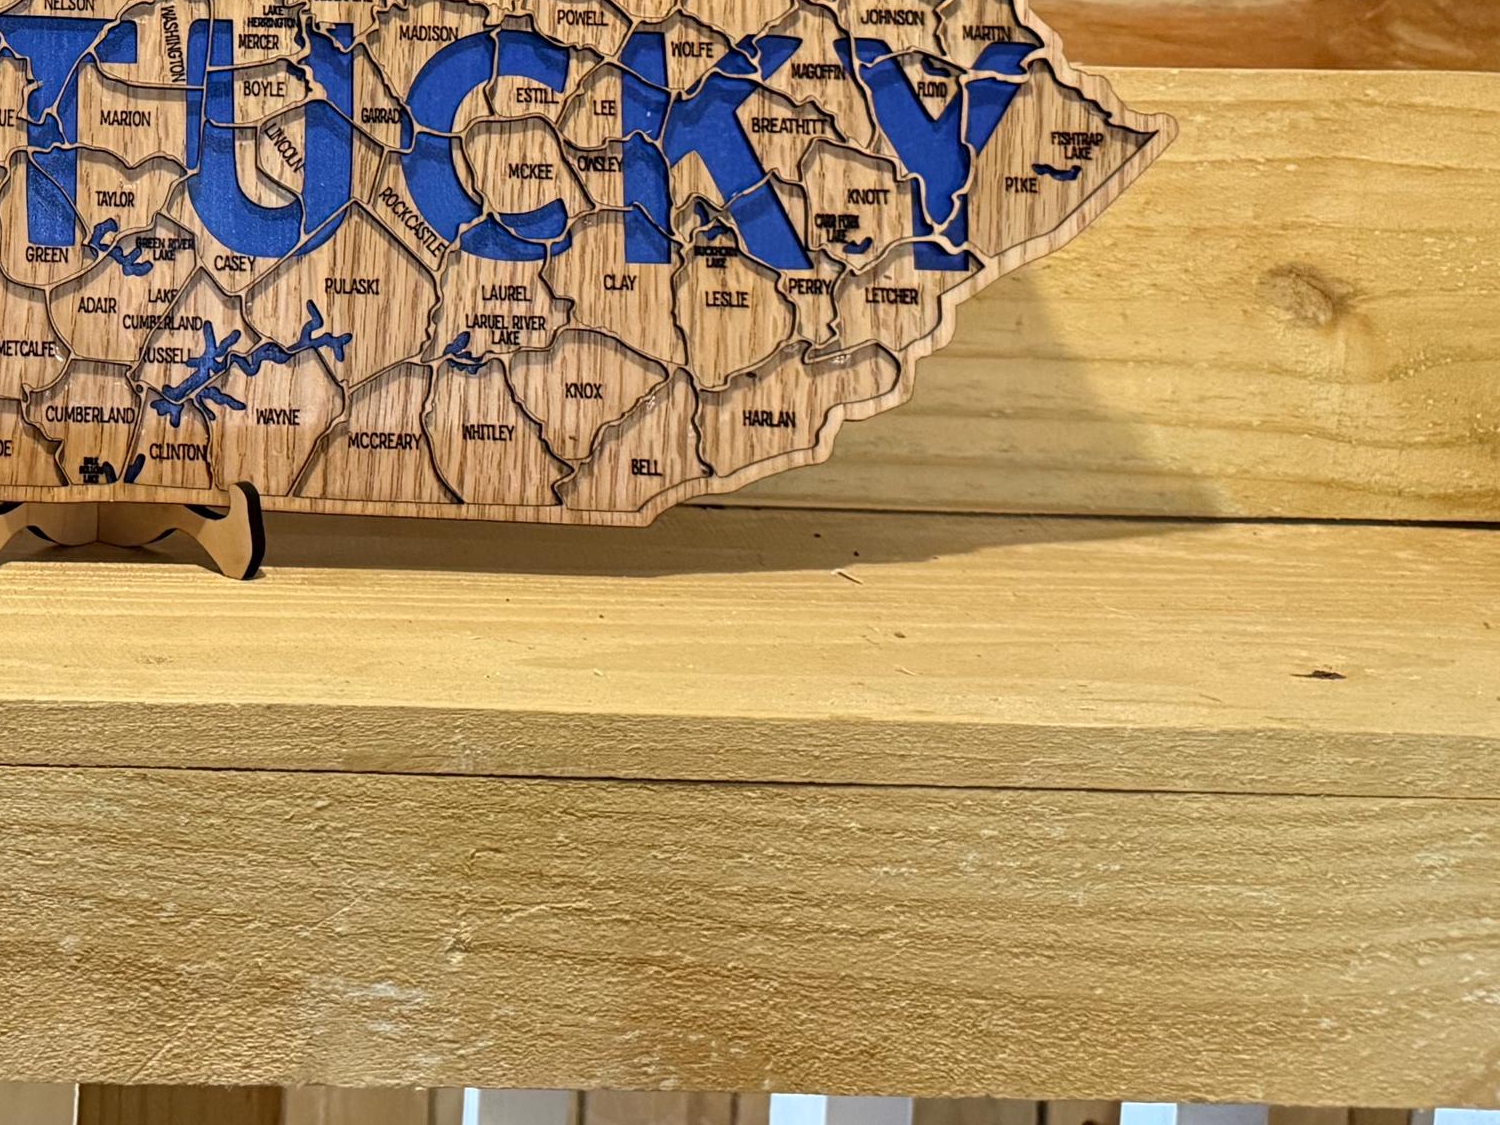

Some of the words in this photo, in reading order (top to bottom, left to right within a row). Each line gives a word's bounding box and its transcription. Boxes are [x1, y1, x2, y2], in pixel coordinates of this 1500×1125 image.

[557, 9, 608, 25] POWELL
[861, 9, 924, 25] JOHNSON
[238, 34, 279, 50] MERCER
[399, 25, 459, 42] MADISON
[963, 25, 1011, 42] MARTIN
[161, 5, 186, 83] WASHINGTON
[671, 41, 713, 58] WOLFE
[791, 63, 846, 80] MAGOFFIN
[243, 80, 285, 97] BOYLE
[516, 88, 559, 104] ESTILL
[917, 81, 947, 98] FLOYD
[593, 100, 615, 115] LEE
[101, 110, 150, 126] MARION
[751, 118, 827, 135] BREATHITT
[1051, 131, 1103, 146] FISHTRAP
[264, 123, 305, 173] LINCOLN
[1064, 146, 1092, 160] LAKE
[509, 163, 553, 180] MCKEE
[577, 156, 622, 172] OWSLEY
[1005, 177, 1037, 193] PIKE
[96, 191, 134, 207] TAYLOR
[848, 189, 890, 205] KNOTT
[379, 187, 447, 257] ROCKCASTLE
[26, 247, 68, 263] GREEN
[153, 249, 175, 261] LAKE
[214, 255, 254, 271] CASEY
[325, 278, 380, 295] PULASKI
[604, 275, 636, 290] CLAY
[788, 278, 832, 295] PERRY
[482, 285, 532, 302] LAUREL
[705, 291, 749, 308] LESLIE
[865, 287, 919, 305] LETCHER
[78, 297, 117, 314] ADAIR
[466, 314, 509, 330] LARUEL
[513, 315, 546, 331] RIVER
[492, 330, 520, 345] LAKE
[565, 383, 603, 399] KNOX
[45, 407, 135, 425] CUMBERLAND
[256, 409, 300, 425] WAYNE
[743, 410, 796, 428] HARLAN
[463, 424, 514, 441] WHITLEY
[348, 433, 421, 450] MCCREARY
[150, 443, 207, 461] CLINTON
[631, 459, 662, 476] BELL
